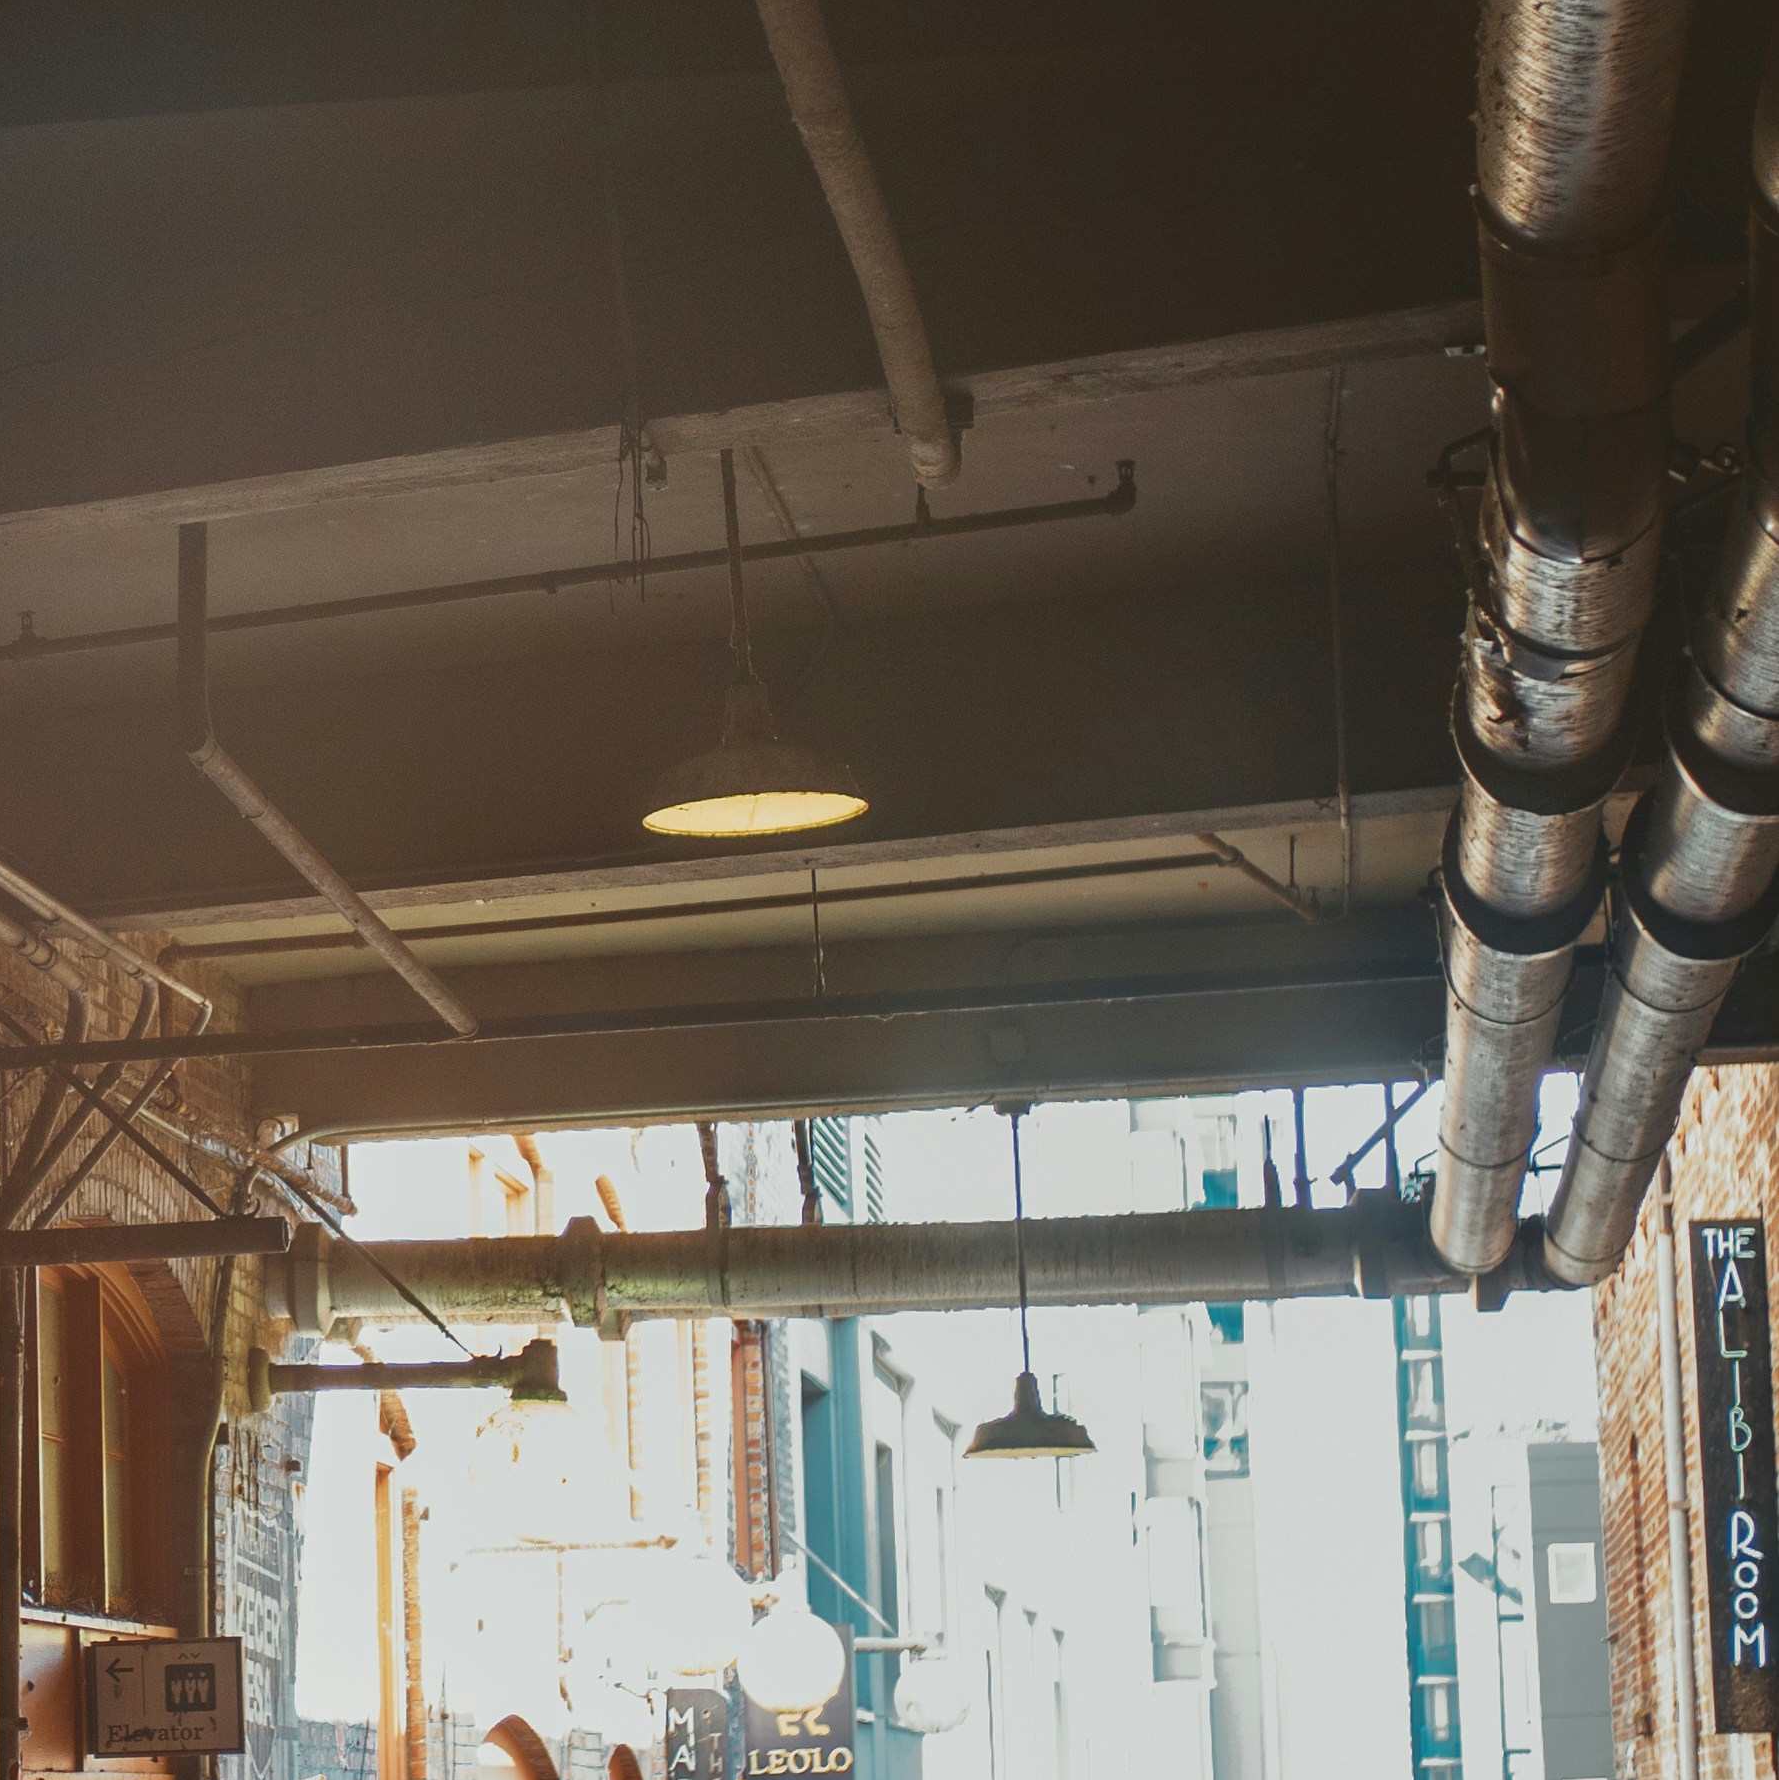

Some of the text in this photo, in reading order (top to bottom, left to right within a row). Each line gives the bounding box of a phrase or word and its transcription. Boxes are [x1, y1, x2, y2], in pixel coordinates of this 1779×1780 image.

[1701, 1227, 1756, 1259] THE
[1718, 1258, 1753, 1500] ALIBI
[1730, 1511, 1766, 1668] ROOM
[107, 1724, 204, 1742] Elevator
[748, 1747, 854, 1775] LEOLO
